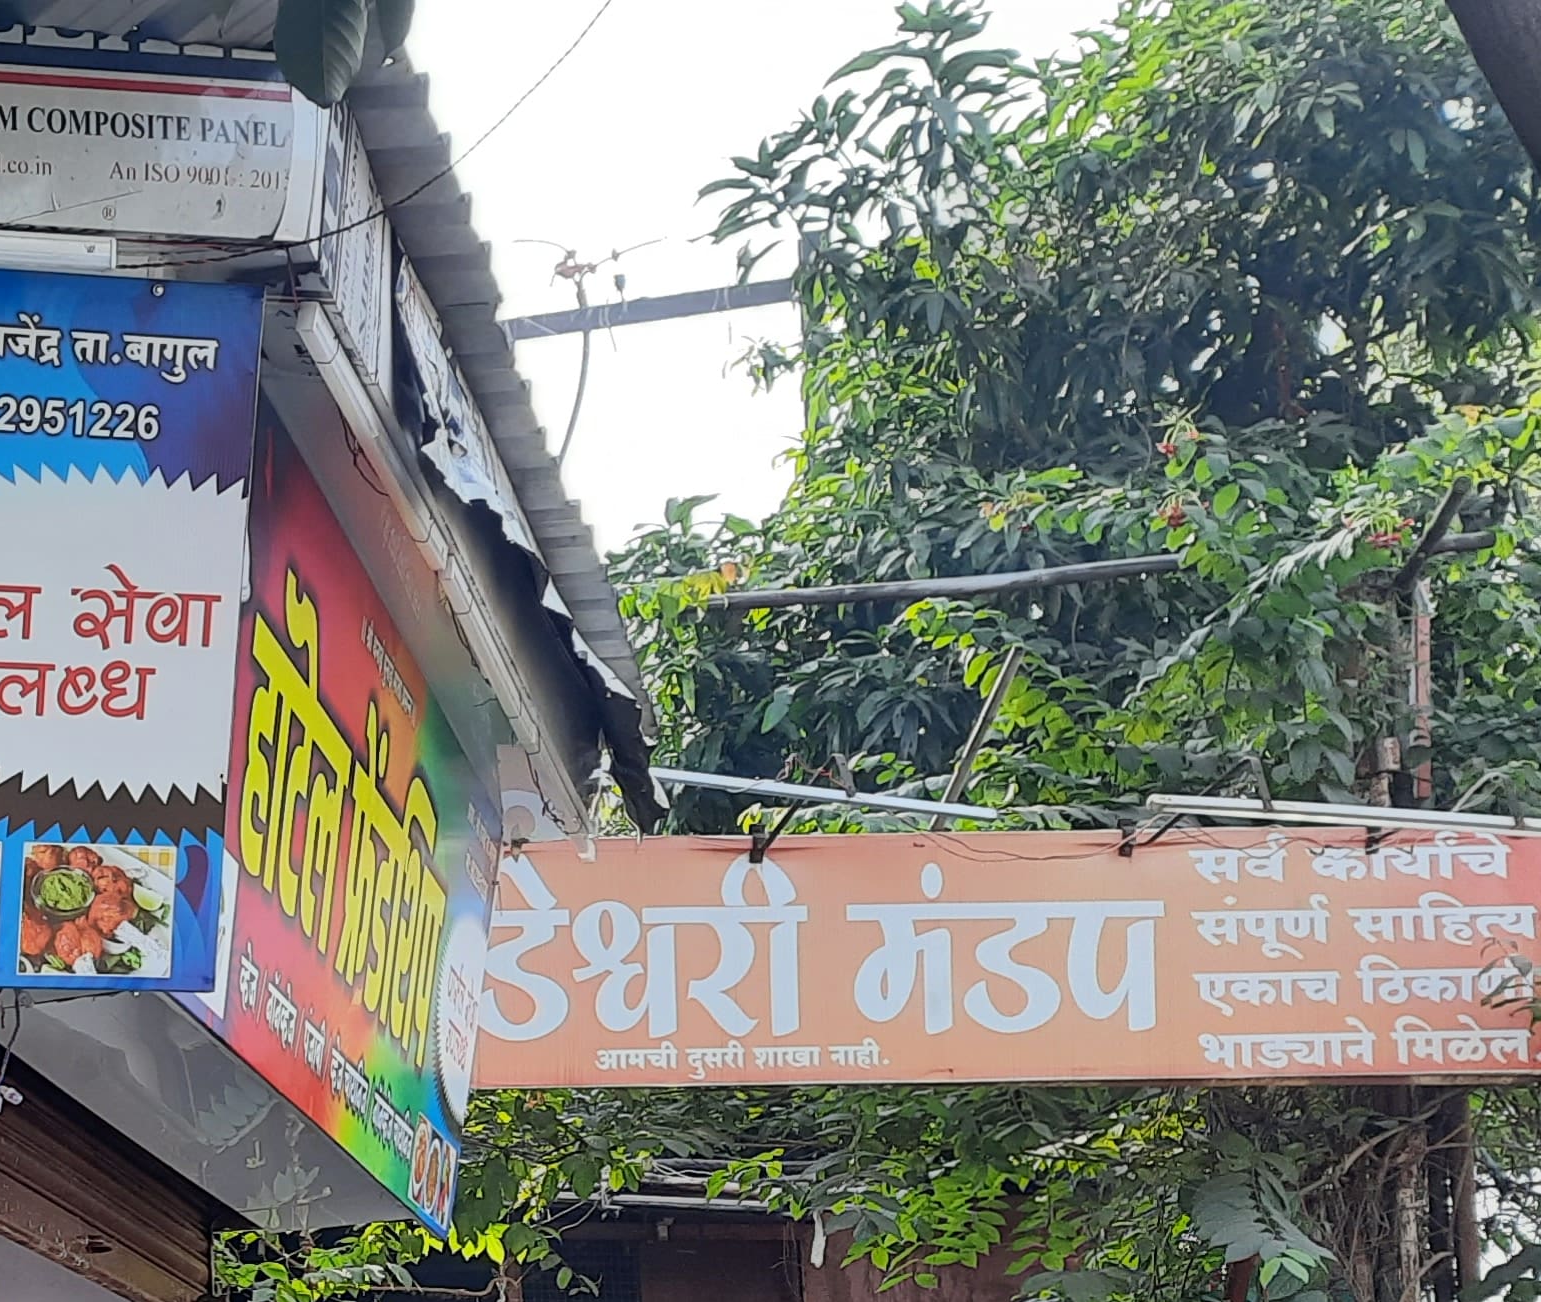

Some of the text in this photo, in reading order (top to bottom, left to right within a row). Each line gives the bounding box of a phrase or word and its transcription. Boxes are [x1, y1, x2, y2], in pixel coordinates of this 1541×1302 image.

[27, 106, 191, 142] COMPOSITE
[200, 118, 287, 149] PANEL
[109, 161, 138, 183] An
[144, 163, 181, 184] ISO
[71, 564, 222, 650] सेवा
[240, 568, 352, 956] हॉटेल
[1189, 832, 1288, 883] सर्व
[846, 862, 1165, 1034] मंडप
[1190, 891, 1538, 960] संपूर्ण साहित्य
[1192, 970, 1341, 1017] एकाच
[595, 1040, 677, 1072] आमची
[686, 1040, 744, 1080] दुसरी
[755, 1045, 821, 1070] शाखा
[1197, 1015, 1376, 1068] भाड्याने
